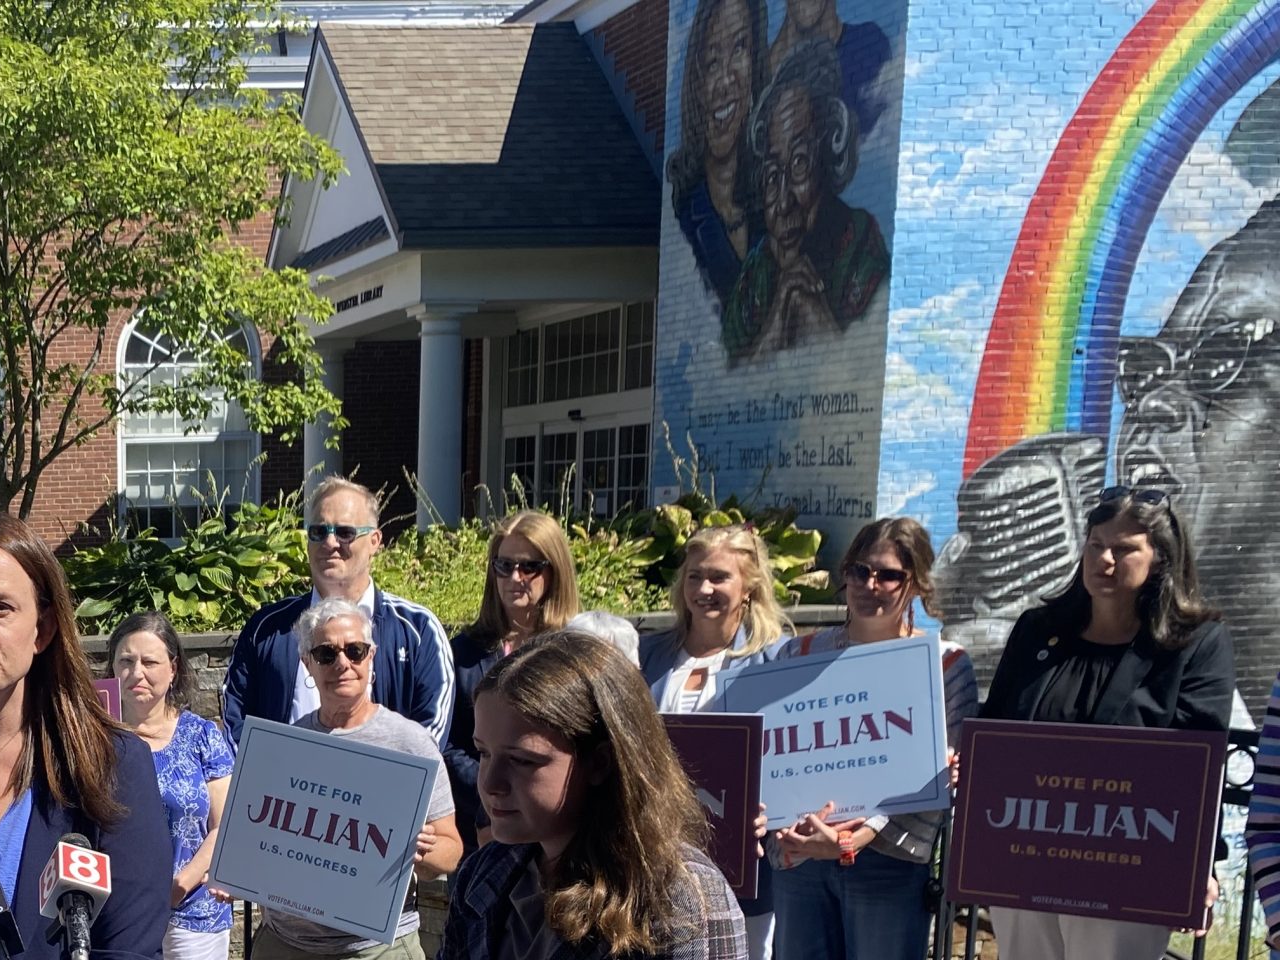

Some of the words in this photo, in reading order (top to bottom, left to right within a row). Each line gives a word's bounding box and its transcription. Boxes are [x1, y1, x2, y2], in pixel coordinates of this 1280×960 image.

[698, 411, 723, 435] may
[727, 403, 741, 425] be
[746, 400, 767, 422] the
[771, 392, 806, 420] first
[725, 441, 734, 470] I
[778, 439, 792, 468] be
[795, 441, 820, 467] the
[824, 485, 873, 518] Harris
[784, 698, 828, 714] VOTE
[834, 691, 869, 706] FOR
[770, 768, 798, 779] U.S.
[804, 754, 888, 775] CONGRESS
[290, 777, 328, 796] VOTE
[331, 788, 362, 806] FOR
[1035, 775, 1086, 790] VOTE
[1092, 779, 1133, 793] FOR
[247, 795, 393, 859] JILLIAN
[985, 797, 1179, 843] JILLIAN
[69, 849, 101, 884] 8
[259, 841, 282, 856] U.S.
[287, 849, 359, 877] CONGRESS
[1010, 843, 1041, 856] U.S.
[1047, 847, 1142, 865] CONGRESS
[43, 857, 56, 899] 8
[268, 894, 325, 917] VOTEFORJILLIAN.COM
[1032, 895, 1109, 910] VOTEFORJILLIAN.COM
